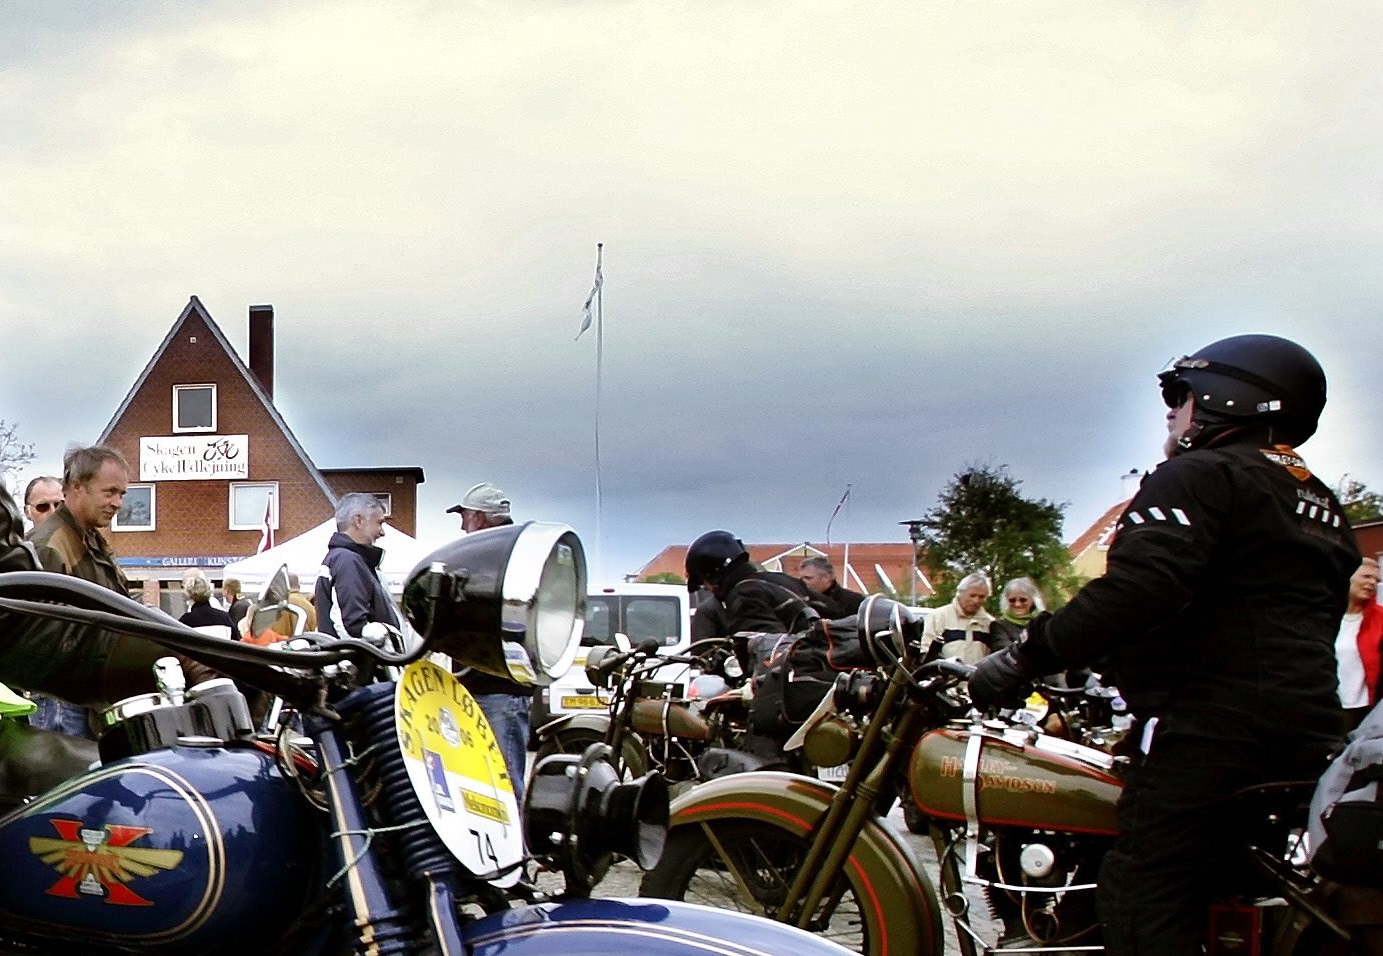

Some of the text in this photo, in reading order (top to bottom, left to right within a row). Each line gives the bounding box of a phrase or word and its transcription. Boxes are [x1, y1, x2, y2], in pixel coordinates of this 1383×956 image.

[147, 444, 196, 457] Skagen
[400, 665, 447, 755] SKAGEN
[468, 827, 500, 870] 74
